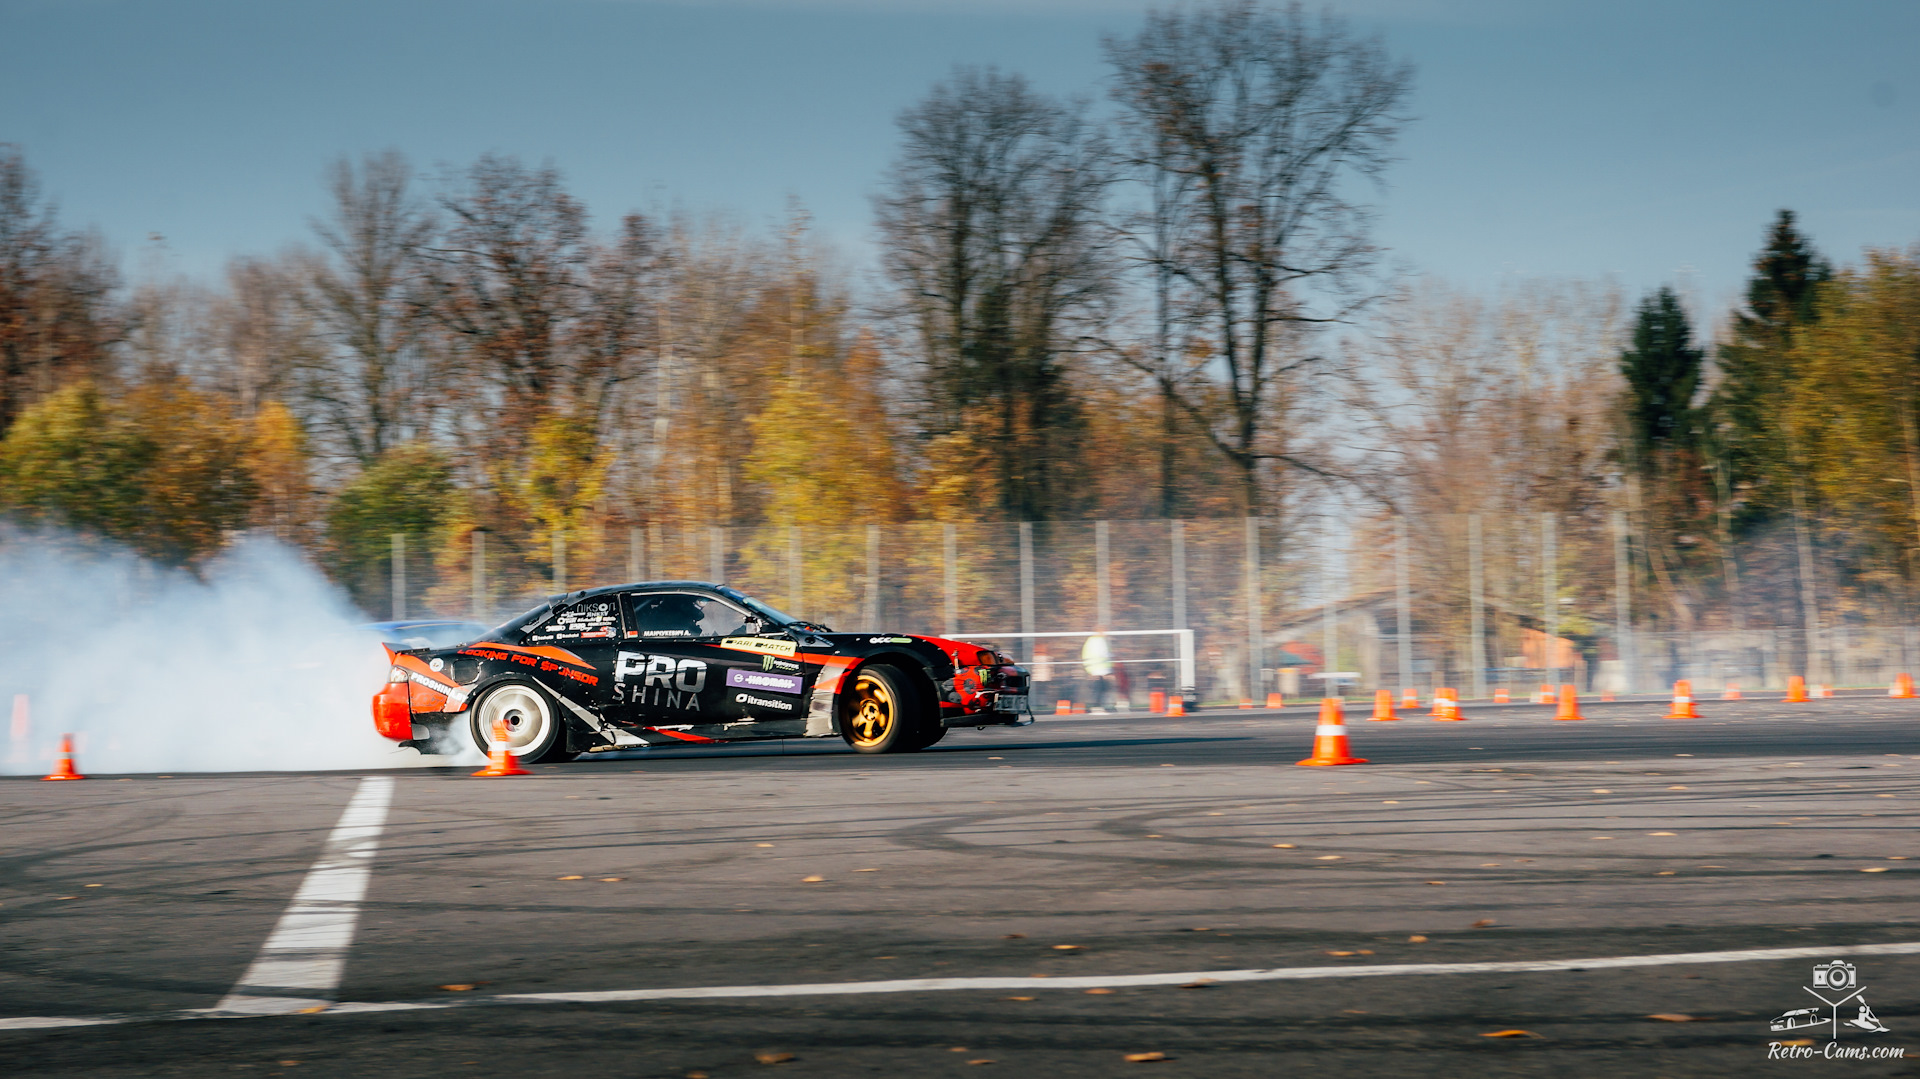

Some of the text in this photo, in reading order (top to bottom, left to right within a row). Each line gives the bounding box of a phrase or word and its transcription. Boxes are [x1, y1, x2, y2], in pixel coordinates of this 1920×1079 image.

[457, 649, 509, 660] LOOKING
[511, 655, 538, 667] FOR
[615, 650, 708, 693] PRO
[612, 682, 701, 712] SHINA
[747, 695, 793, 711] itransition
